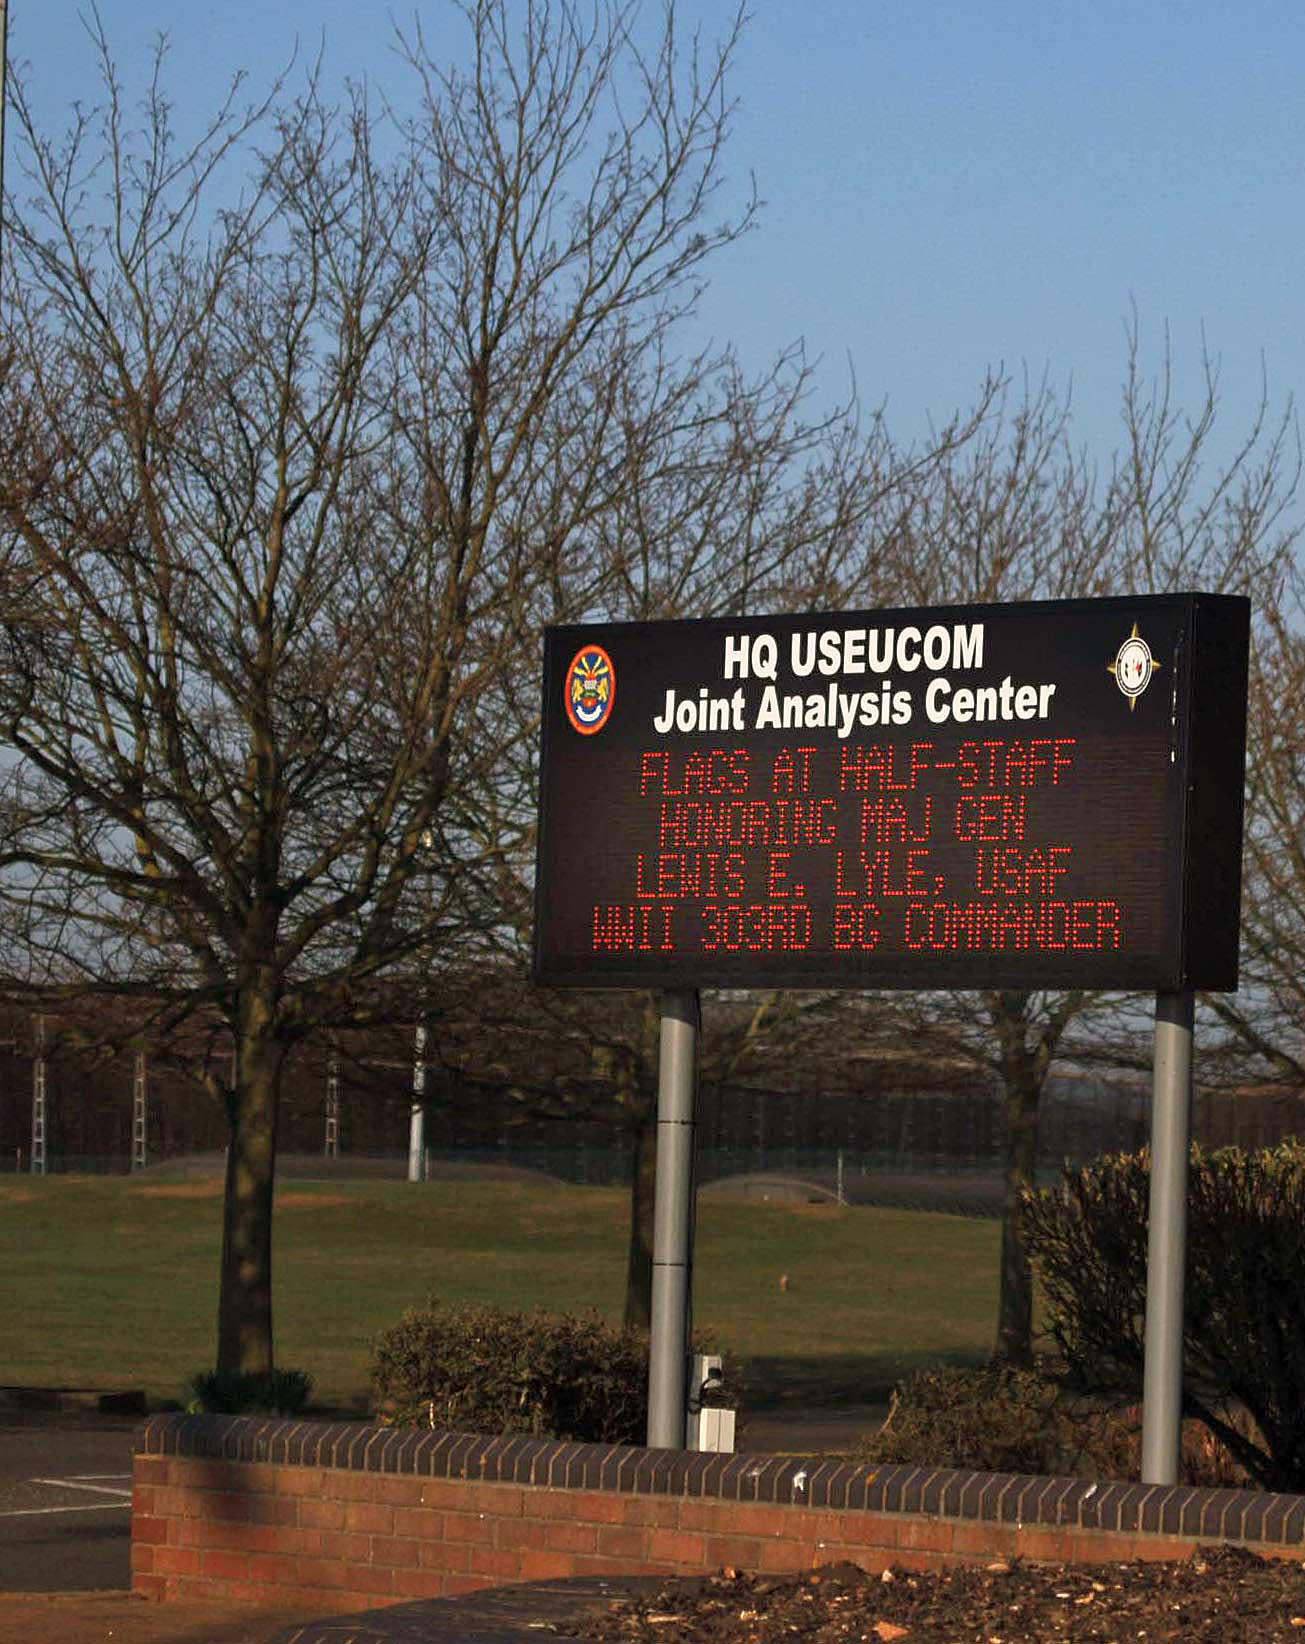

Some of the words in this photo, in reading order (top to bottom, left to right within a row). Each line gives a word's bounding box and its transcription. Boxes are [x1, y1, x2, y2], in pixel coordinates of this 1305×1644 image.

[724, 634, 779, 681] HQ
[791, 623, 985, 676] USEUCOM
[653, 687, 746, 734] Joint
[755, 674, 912, 739] Analysis
[925, 675, 1057, 724] Center
[640, 748, 752, 798] FLAGS
[772, 746, 819, 794] AT
[840, 738, 1077, 792] HALF-STAFF
[659, 796, 839, 848] HONORING
[860, 796, 934, 845] MAJ
[955, 793, 1028, 842] GEN
[636, 851, 747, 899] LEWIS
[766, 848, 807, 898] E.
[831, 849, 945, 897] LYLE,
[975, 847, 1073, 897] USAF
[592, 904, 675, 951] WWII
[700, 903, 813, 951] 303RD
[833, 902, 881, 950] BG
[904, 900, 1121, 950] COMMANDER
